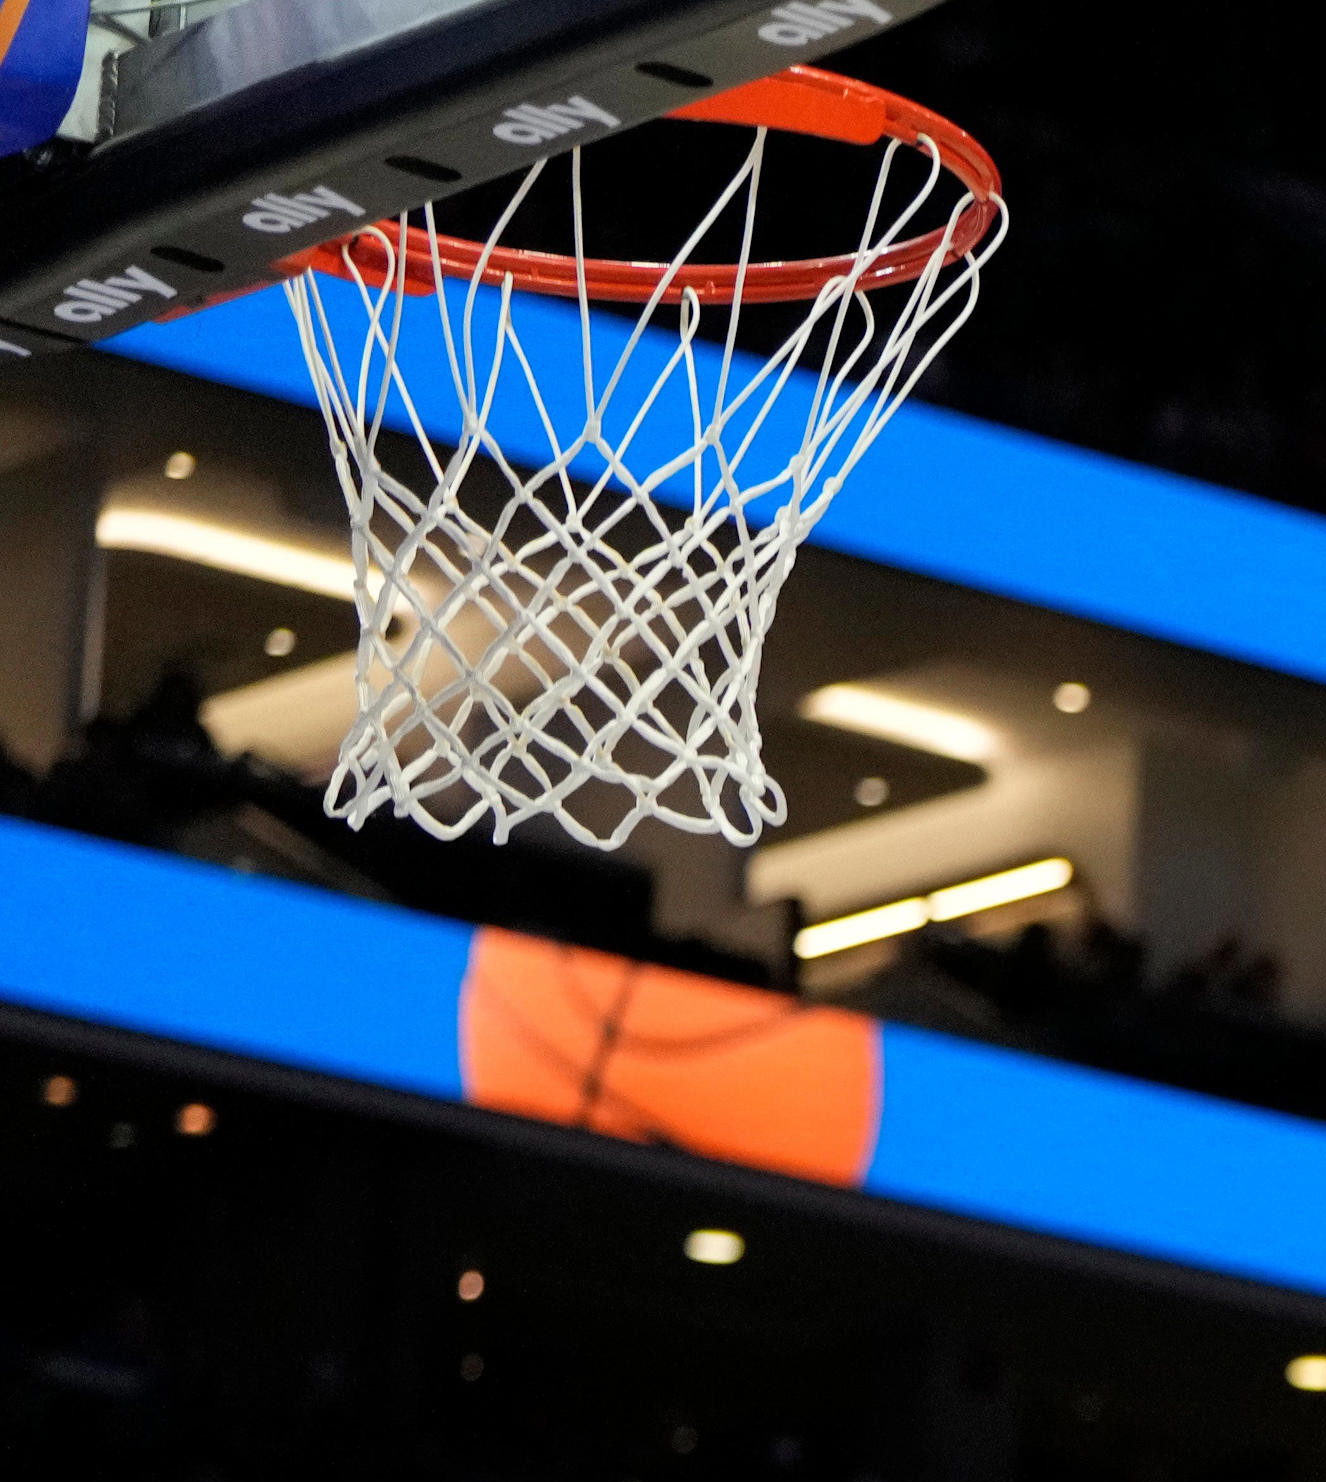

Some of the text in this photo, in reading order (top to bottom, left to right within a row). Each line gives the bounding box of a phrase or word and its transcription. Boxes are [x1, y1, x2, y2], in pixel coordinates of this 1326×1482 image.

[492, 95, 621, 145] ally
[242, 185, 366, 234] ally
[54, 265, 178, 322] ally
